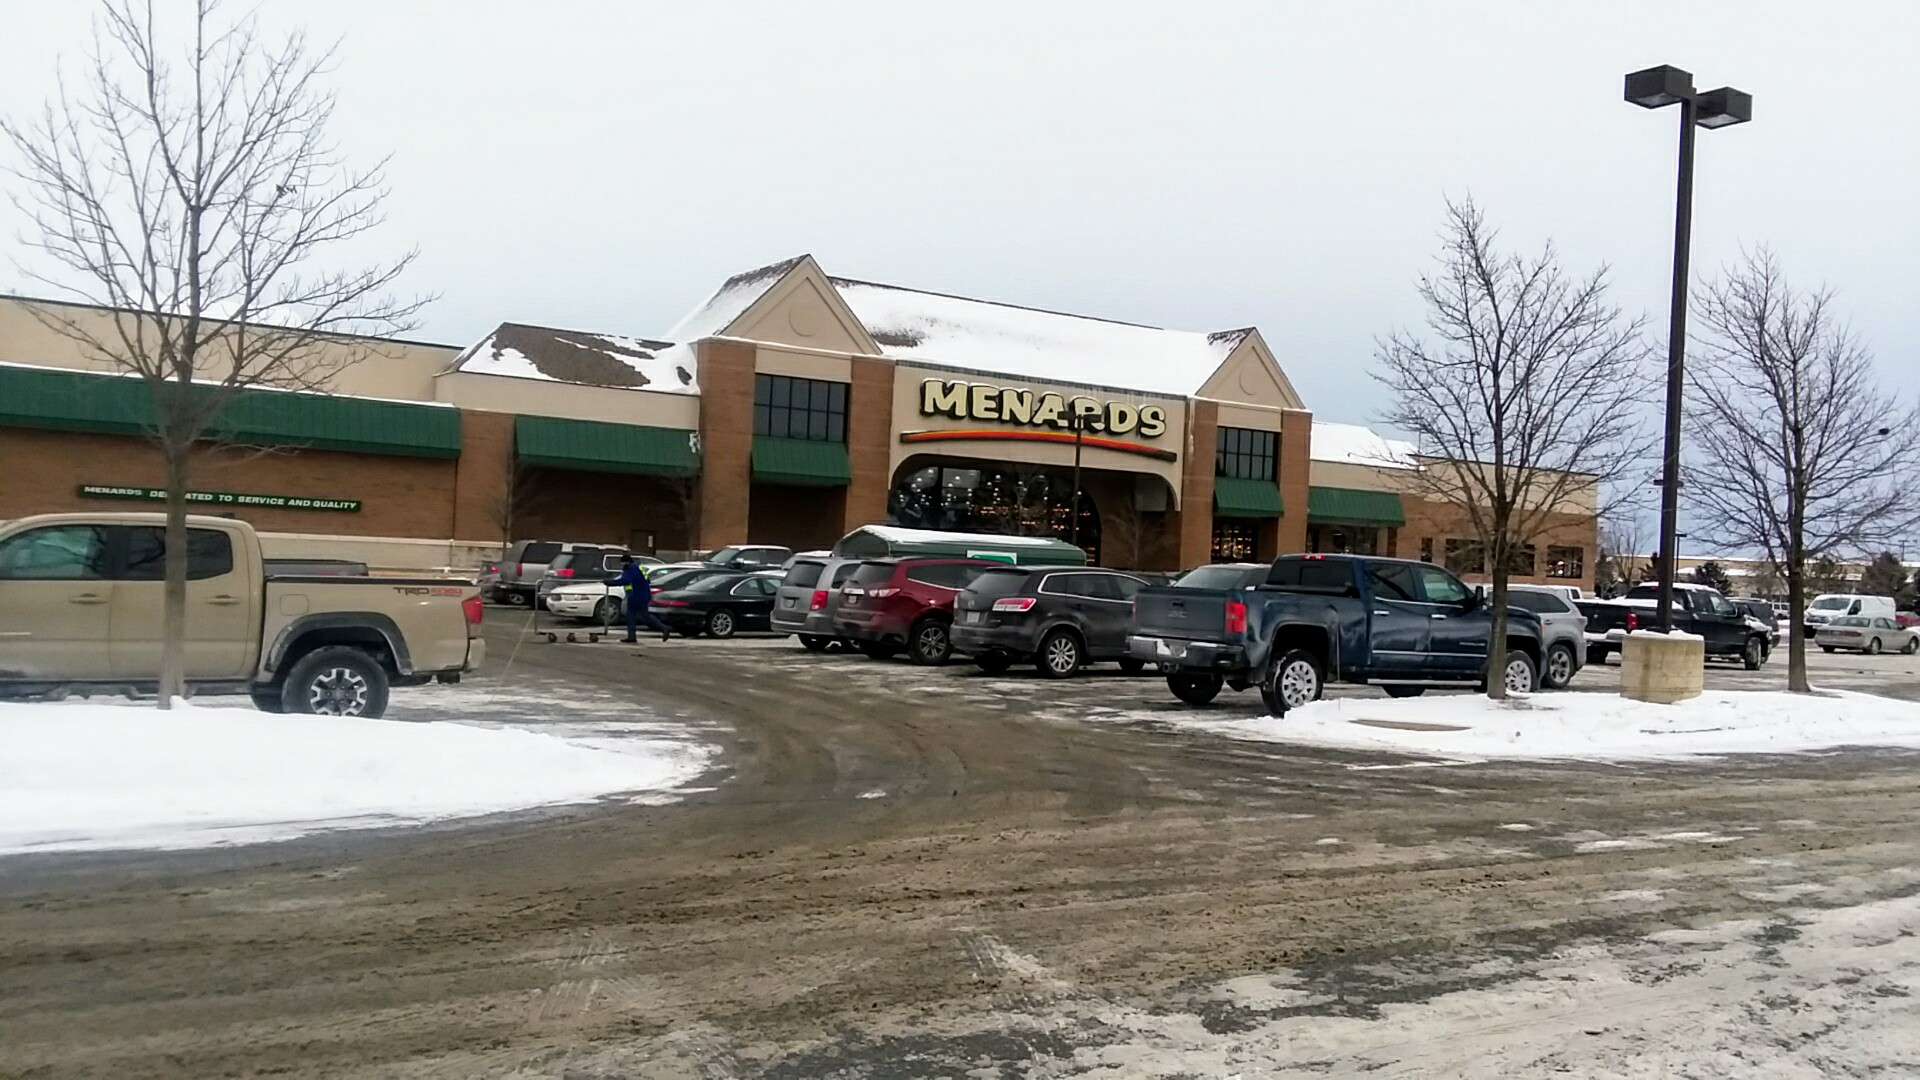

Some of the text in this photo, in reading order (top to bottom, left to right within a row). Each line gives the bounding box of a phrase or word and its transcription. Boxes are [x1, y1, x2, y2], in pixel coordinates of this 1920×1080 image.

[921, 379, 1166, 437] MENARDS
[84, 486, 357, 509] MENARDS DEATED TO SERVICE AND QUALITY
